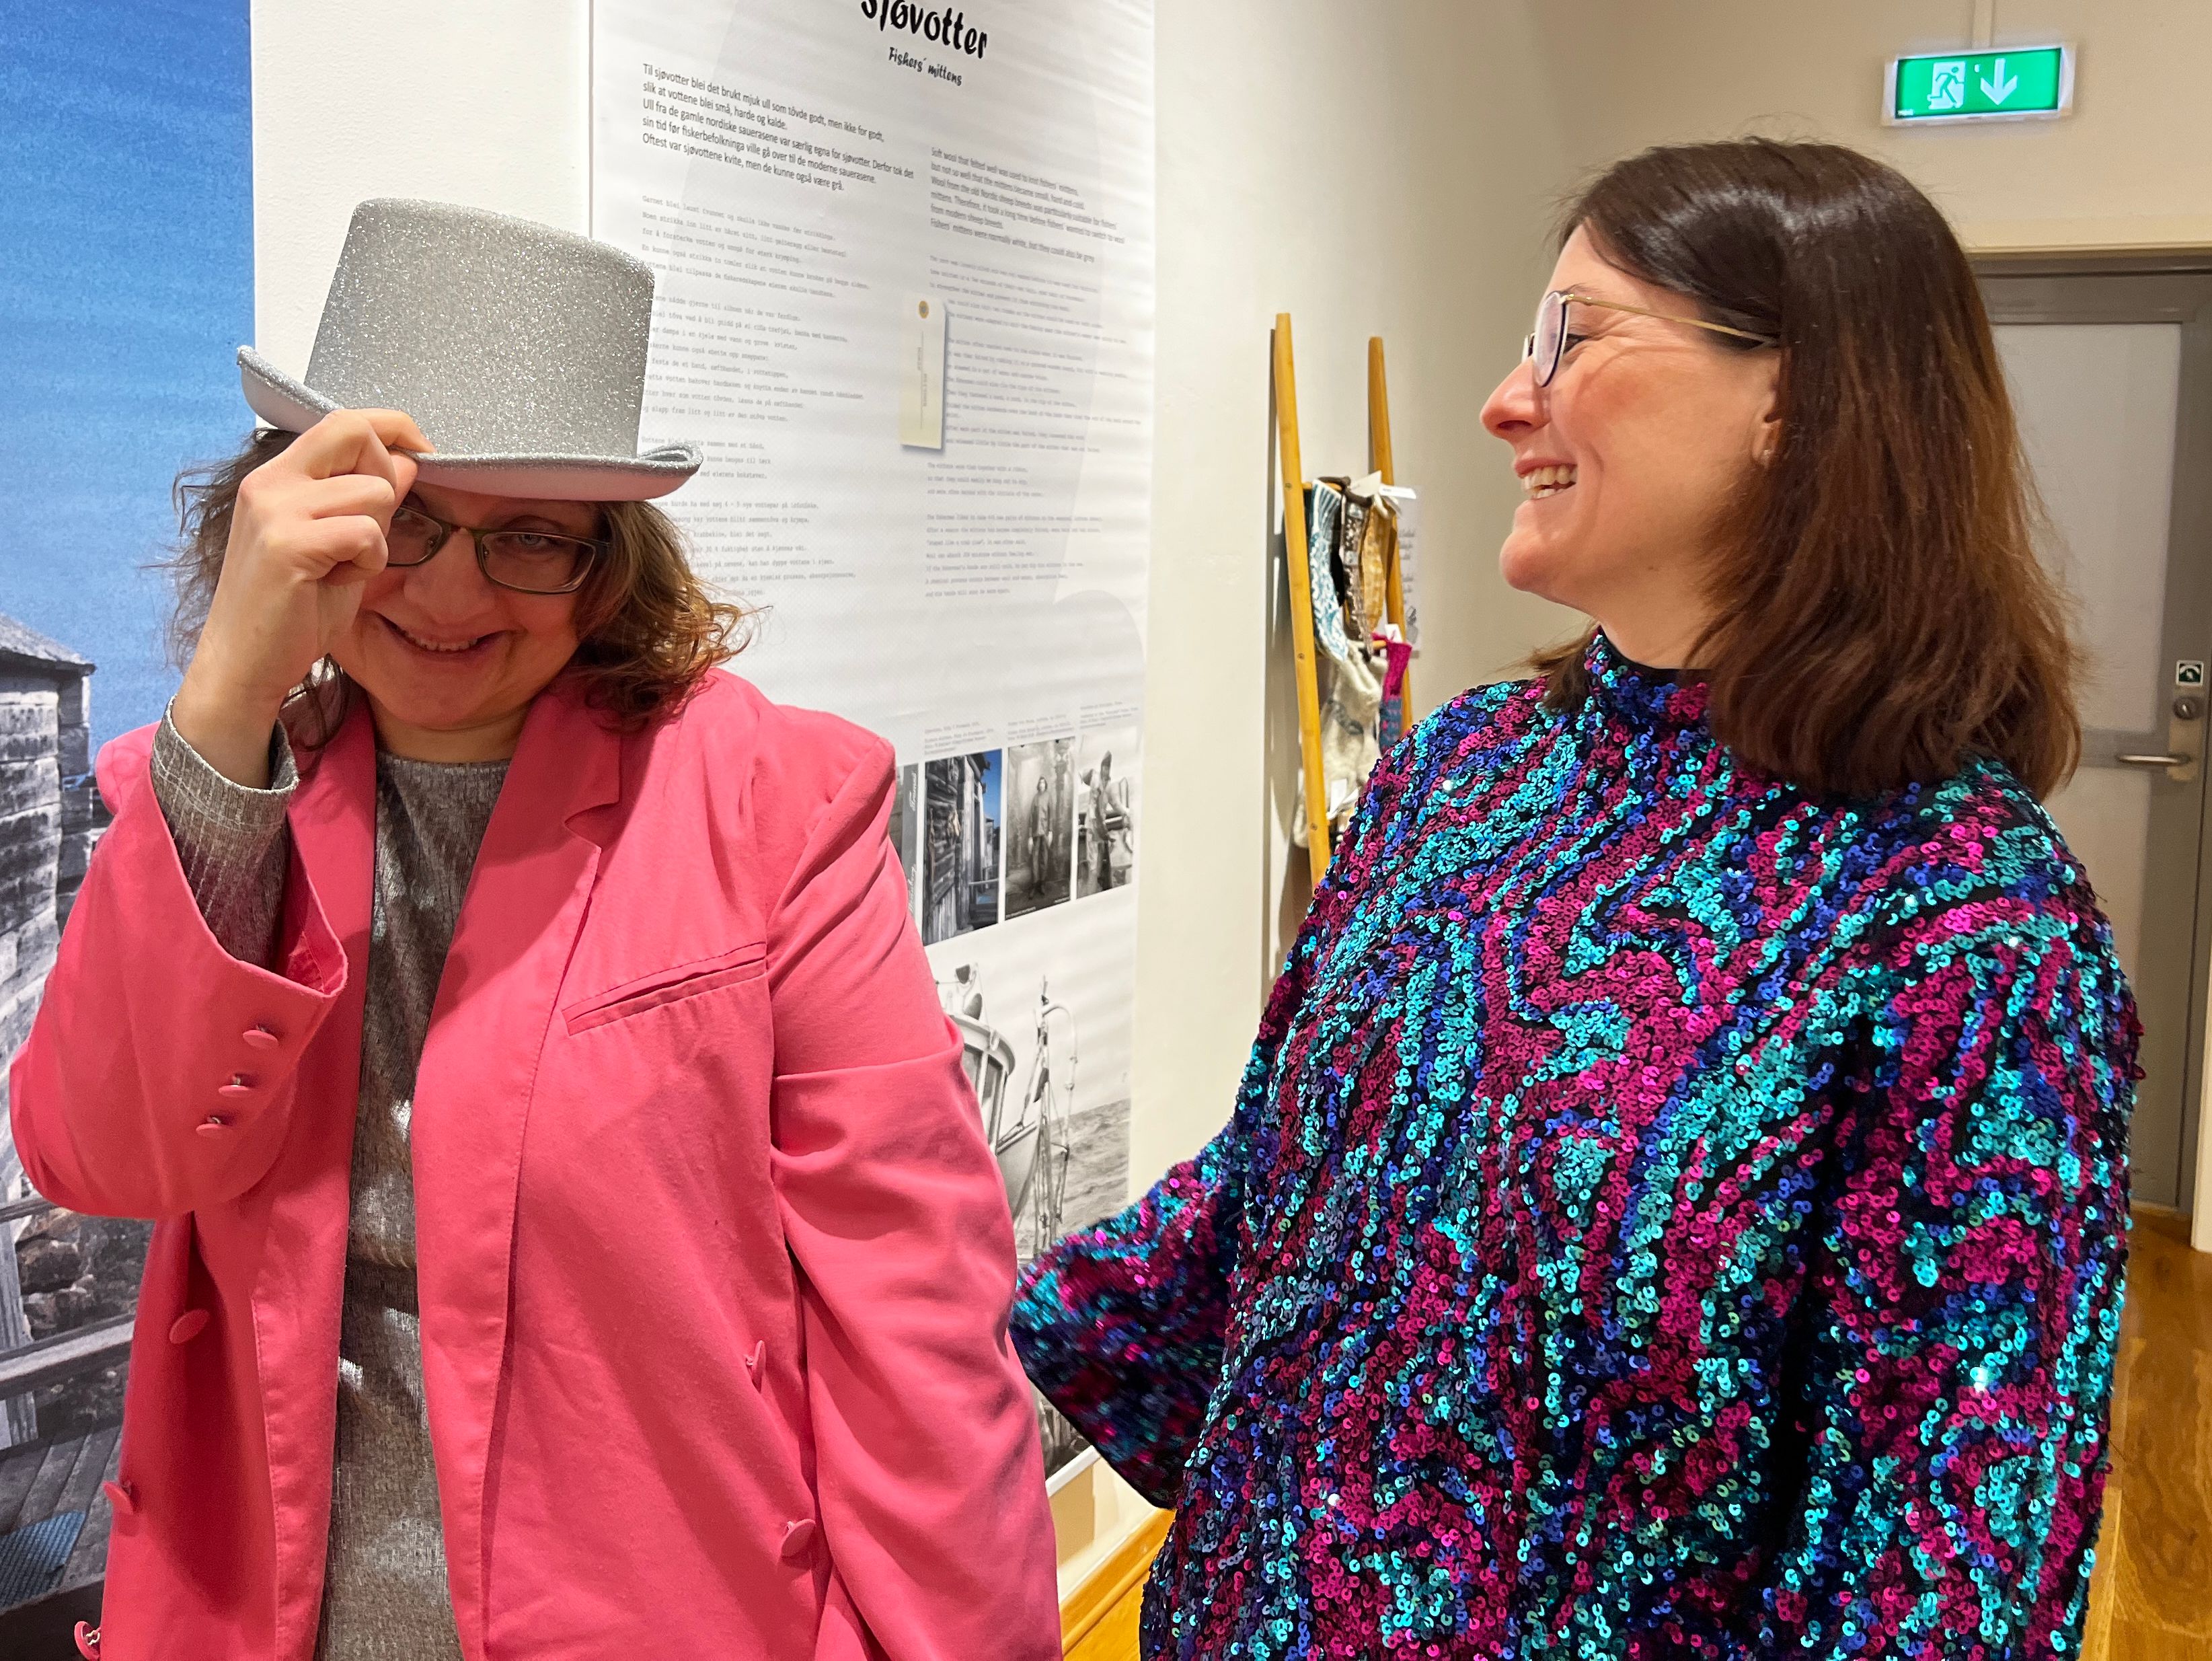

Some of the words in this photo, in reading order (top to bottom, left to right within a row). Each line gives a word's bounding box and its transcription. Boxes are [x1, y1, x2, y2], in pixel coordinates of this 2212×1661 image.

[642, 63, 652, 75] Til
[654, 67, 689, 85] sjøvotter
[691, 77, 705, 91] blei
[708, 82, 719, 95] det
[722, 86, 740, 101] brukt
[742, 94, 759, 106] mjuk
[761, 99, 769, 109] ull
[772, 103, 786, 114] som
[809, 114, 826, 127] godt,
[828, 118, 842, 129] men
[843, 121, 855, 133] ikke
[858, 125, 866, 137] for
[928, 63, 962, 86] mittens
[643, 81, 656, 94] slik
[658, 86, 666, 96] at
[668, 89, 697, 105] vottene
[699, 96, 713, 110] blei
[715, 103, 732, 117] små,
[734, 106, 754, 121] harde
[757, 114, 765, 126] og
[767, 116, 787, 130] kalde.
[642, 116, 654, 127] sin
[656, 118, 666, 131] tid
[669, 122, 679, 134] før
[682, 125, 744, 152] fiskerbefolkninga
[747, 143, 760, 155] ville
[762, 147, 769, 158] gå
[772, 151, 787, 161] over
[797, 155, 805, 166] de
[808, 159, 837, 174] moderne
[642, 132, 666, 148] Oftest
[669, 141, 681, 151] var
[683, 143, 722, 161] sjøvottene
[724, 153, 743, 169] kvite,
[745, 160, 761, 171] men
[763, 162, 771, 174] de
[773, 165, 794, 179] kunne
[796, 172, 811, 184] også
[814, 177, 830, 188] være
[643, 98, 654, 110] Ull
[656, 101, 666, 114] fra
[669, 105, 678, 117] de
[681, 110, 703, 124] gamle
[705, 117, 736, 133] nordiske
[738, 126, 777, 143] sauerasene
[779, 137, 790, 147] var
[792, 140, 812, 155] særlig
[814, 146, 830, 157] egna
[831, 149, 841, 159] for
[872, 159, 891, 173] Derfor
[892, 165, 901, 176] tok
[904, 168, 913, 178] det
